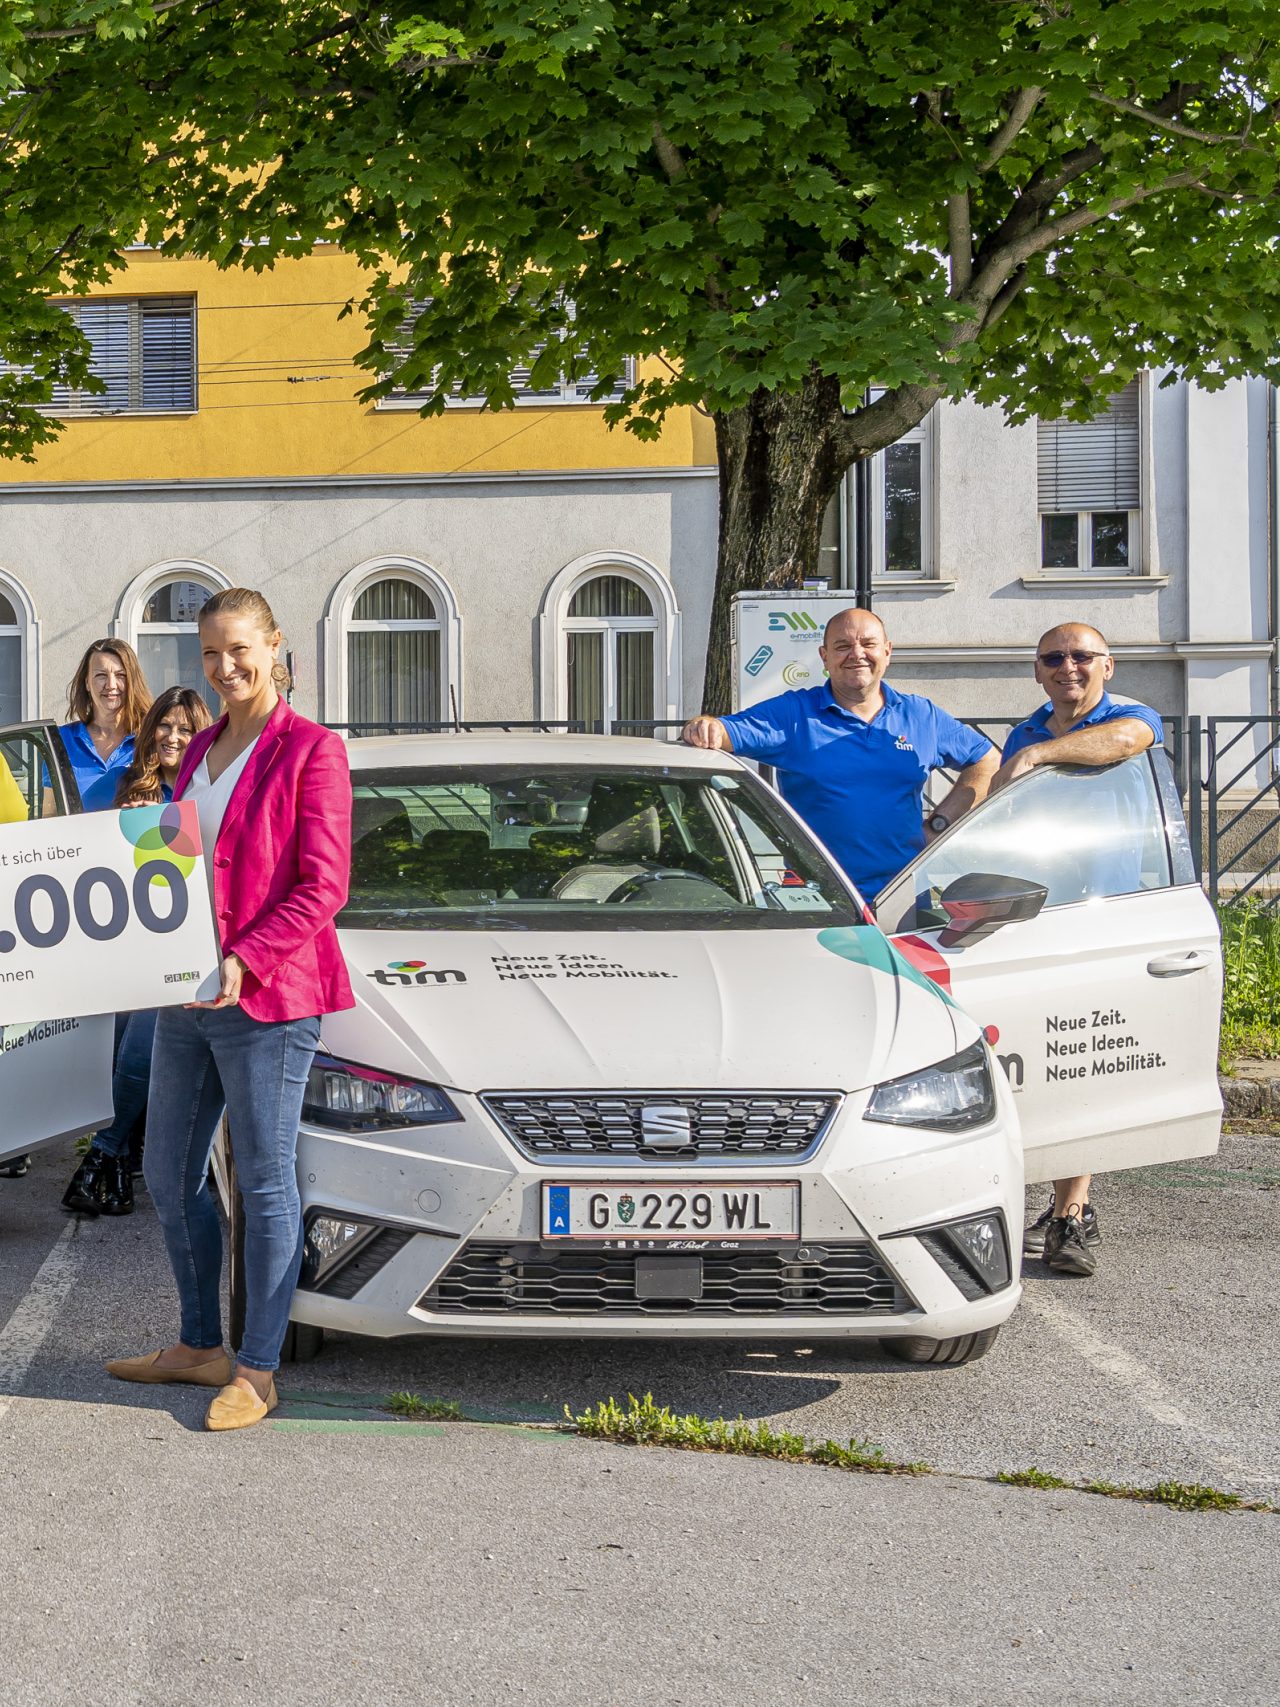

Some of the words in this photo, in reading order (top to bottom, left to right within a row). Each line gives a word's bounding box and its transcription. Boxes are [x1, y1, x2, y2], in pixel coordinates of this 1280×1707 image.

[894, 737, 913, 751] tim
[13, 849, 42, 865] sich
[47, 846, 83, 861] über
[164, 971, 200, 983] GRAZ
[366, 962, 467, 986] tim
[498, 973, 558, 981] Neue
[566, 970, 679, 979] Mobilität.
[1046, 1015, 1087, 1033] Neue
[1091, 1009, 1126, 1028] Zeit.
[1046, 1040, 1087, 1058] Neue
[1092, 1034, 1139, 1052] Ideen.
[1046, 1065, 1087, 1082] Neue
[1091, 1052, 1166, 1076] Mobilität.
[589, 1193, 610, 1229] G
[642, 1193, 712, 1229] 229
[723, 1193, 771, 1229] WL
[554, 1216, 565, 1228] A
[720, 1241, 740, 1249] Graz
